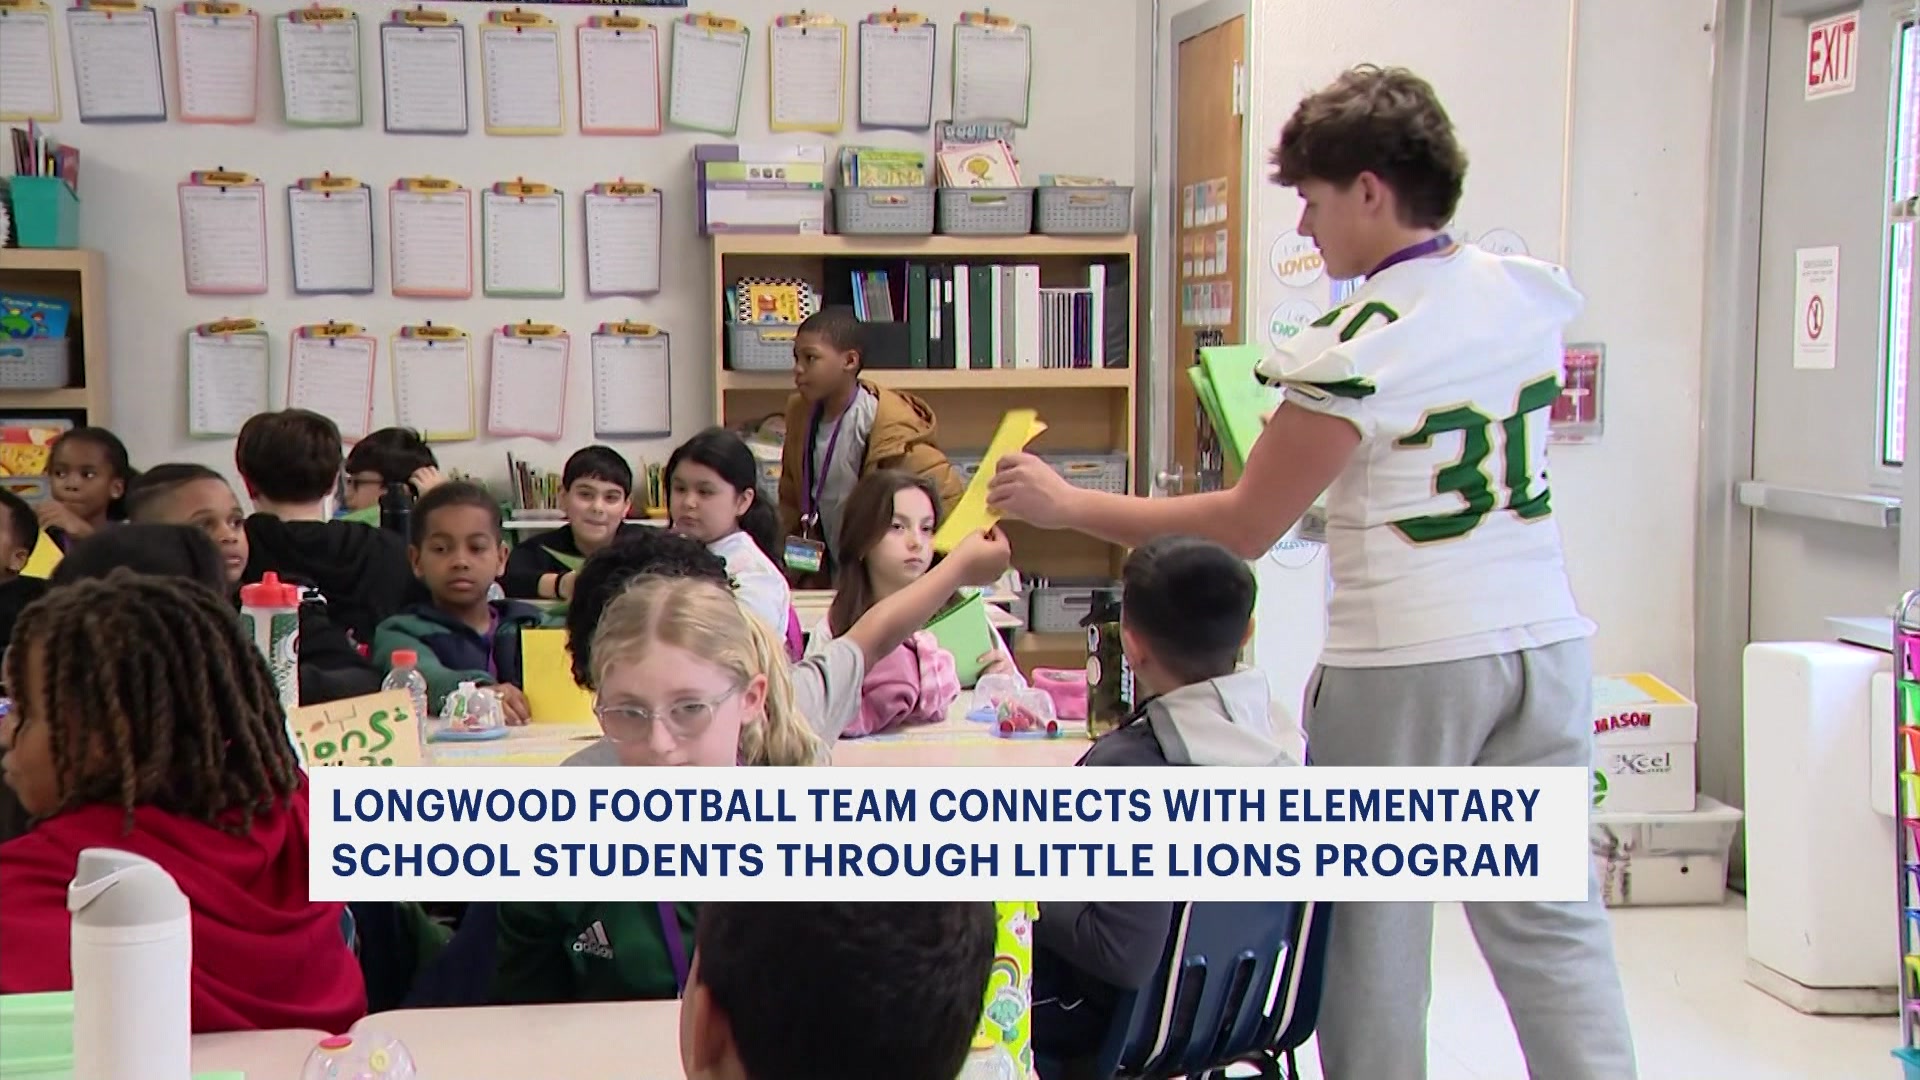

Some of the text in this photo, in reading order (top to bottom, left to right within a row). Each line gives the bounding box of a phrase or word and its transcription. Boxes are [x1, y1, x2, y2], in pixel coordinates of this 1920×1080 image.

[1809, 21, 1856, 86] EXIT
[1391, 371, 1560, 547] 30
[1593, 712, 1652, 735] MASON
